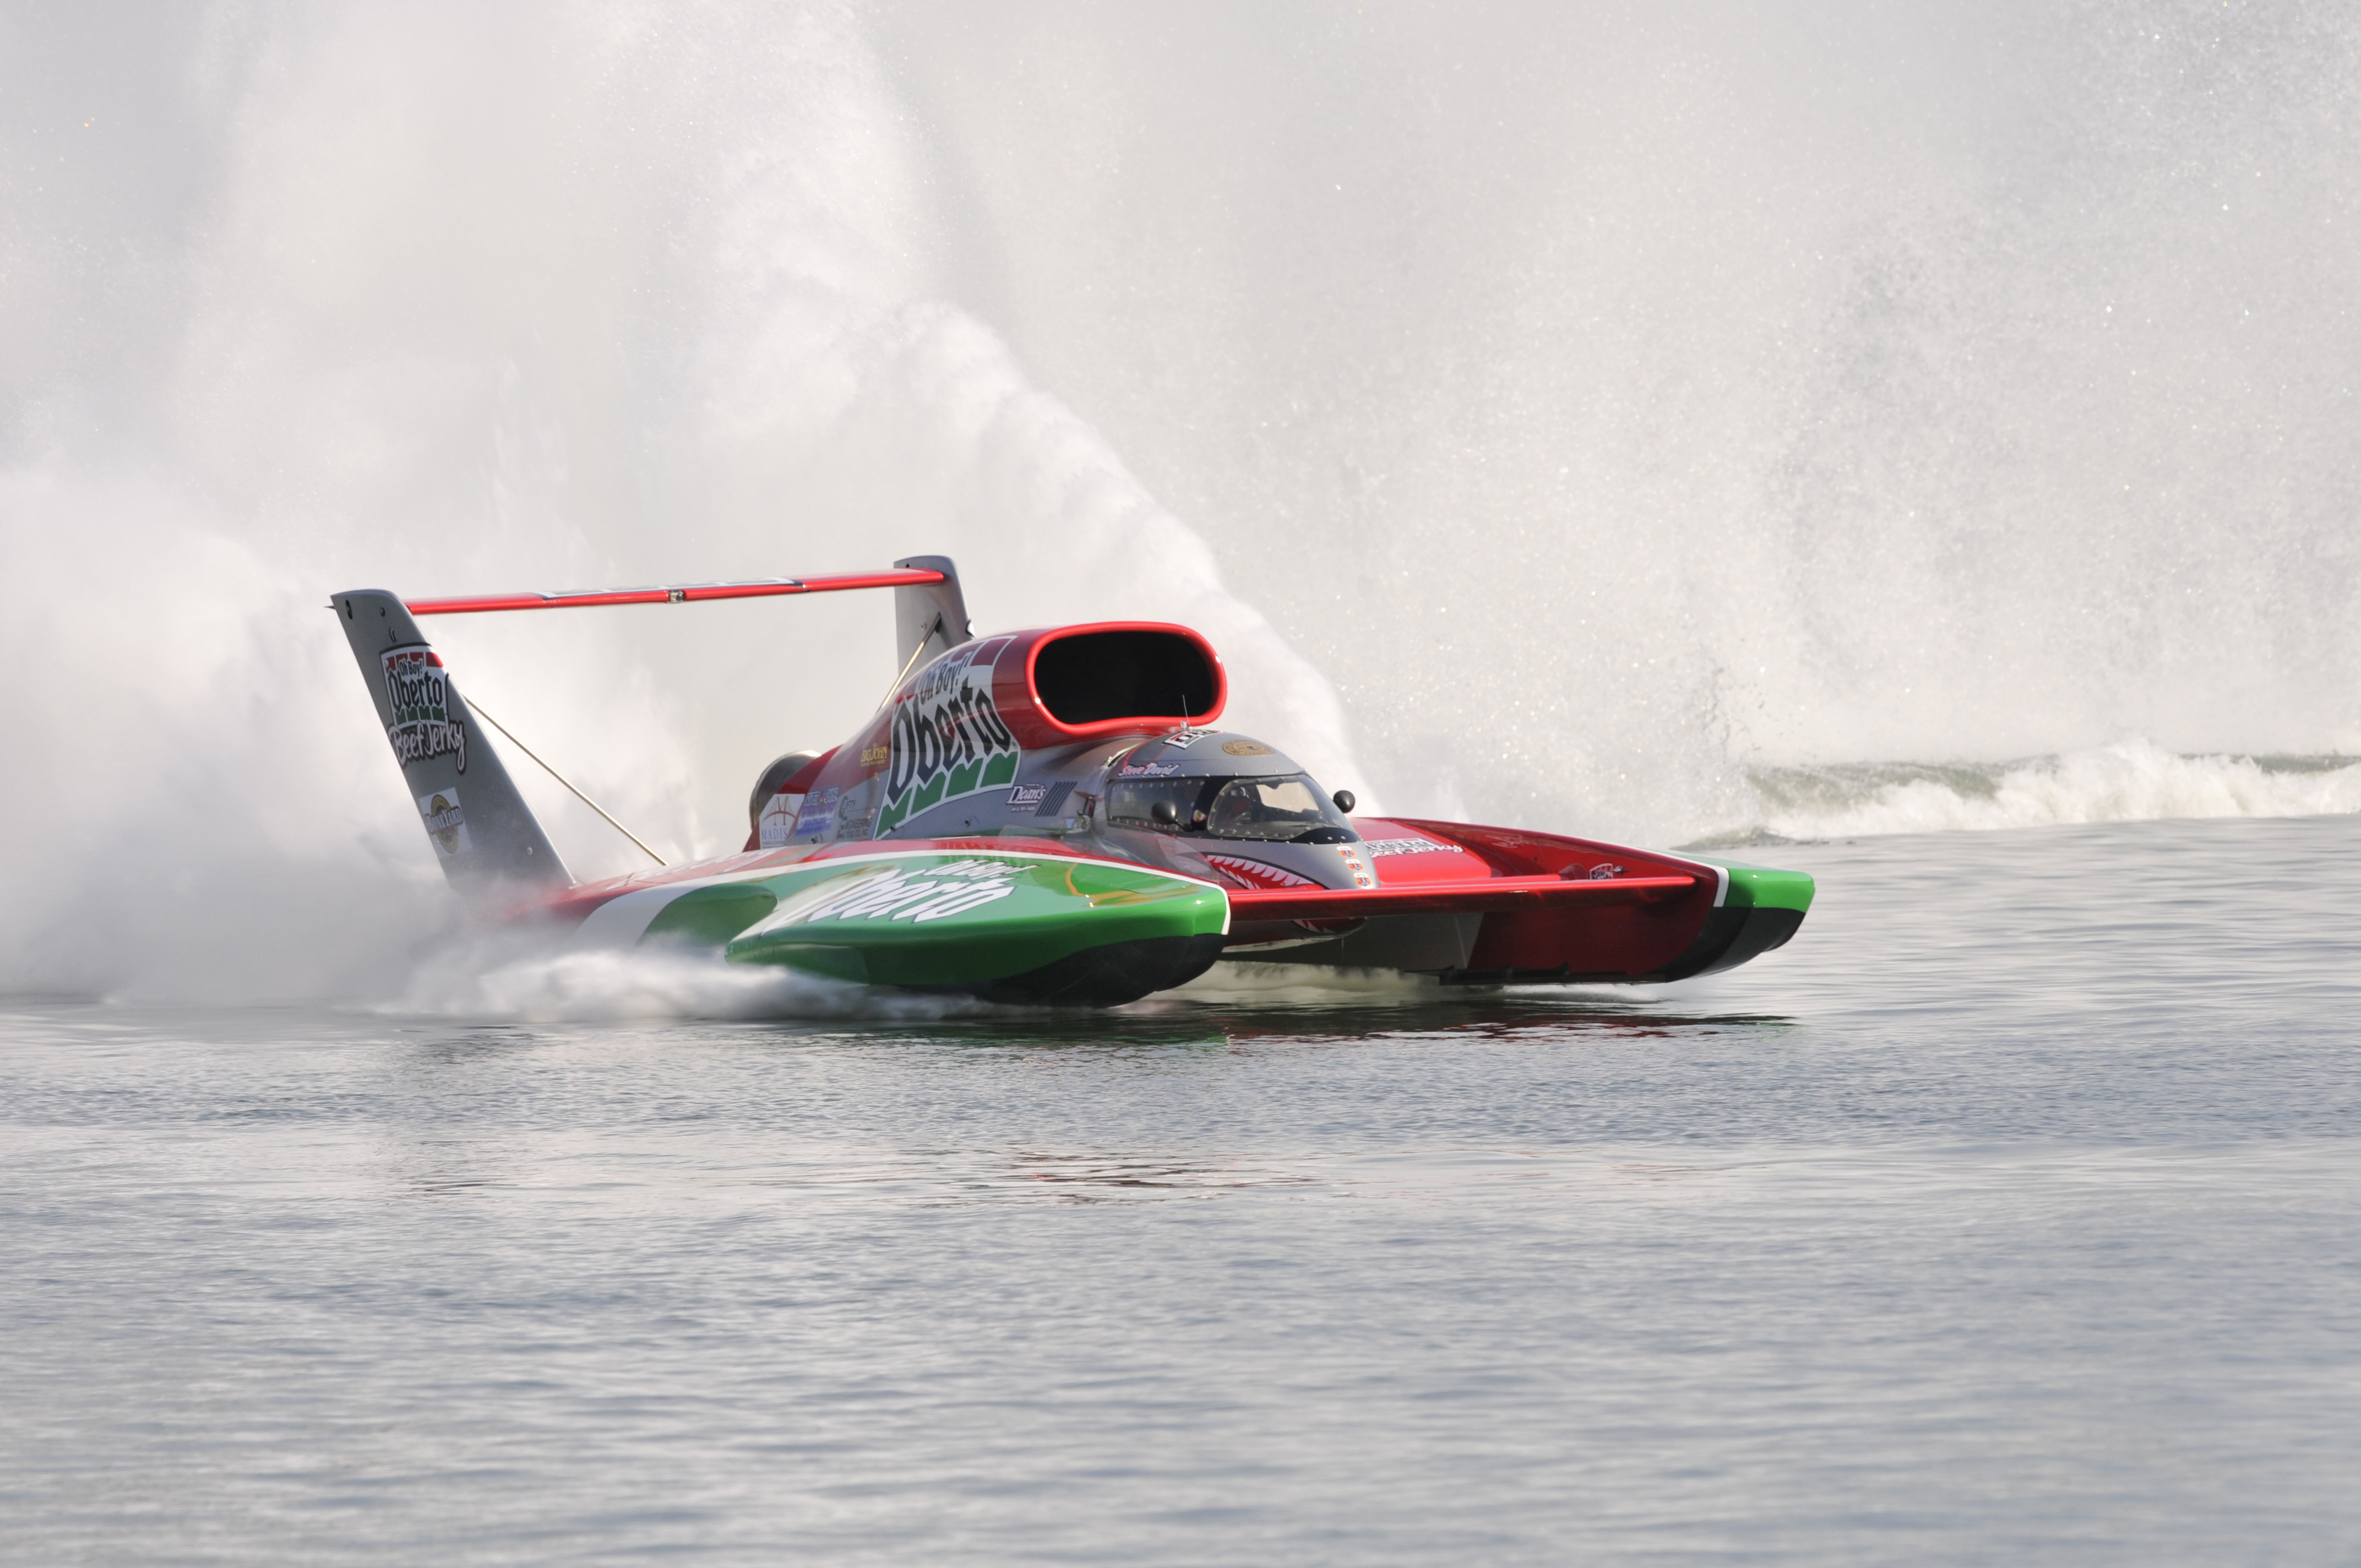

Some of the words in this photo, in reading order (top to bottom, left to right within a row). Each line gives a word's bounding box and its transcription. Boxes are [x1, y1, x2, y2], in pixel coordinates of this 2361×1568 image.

[399, 661, 409, 677] Oh
[408, 660, 423, 677] Boy!
[935, 655, 968, 695] Boy!
[388, 669, 443, 714] Oberto
[388, 721, 425, 766] Beef
[424, 715, 465, 771] Jerky
[886, 676, 1011, 806] Oberto
[1007, 785, 1046, 804] Dean's
[1403, 844, 1465, 854] Jerky
